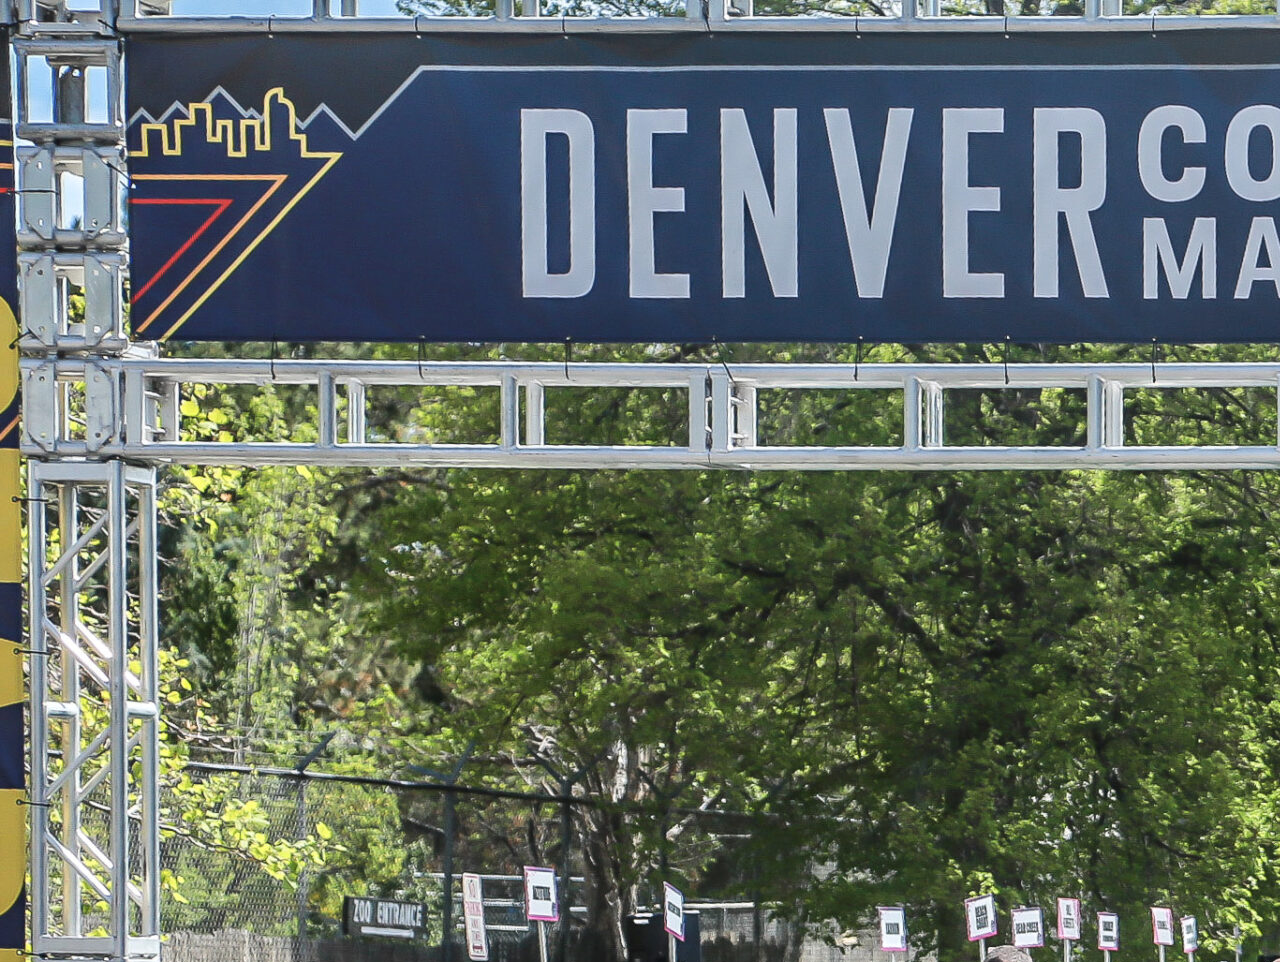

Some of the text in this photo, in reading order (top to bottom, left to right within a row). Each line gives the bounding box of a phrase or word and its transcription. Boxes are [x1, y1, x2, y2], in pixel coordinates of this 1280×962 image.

[520, 107, 1110, 299] DENVER
[353, 899, 422, 927] ZOO ENTRANCE
